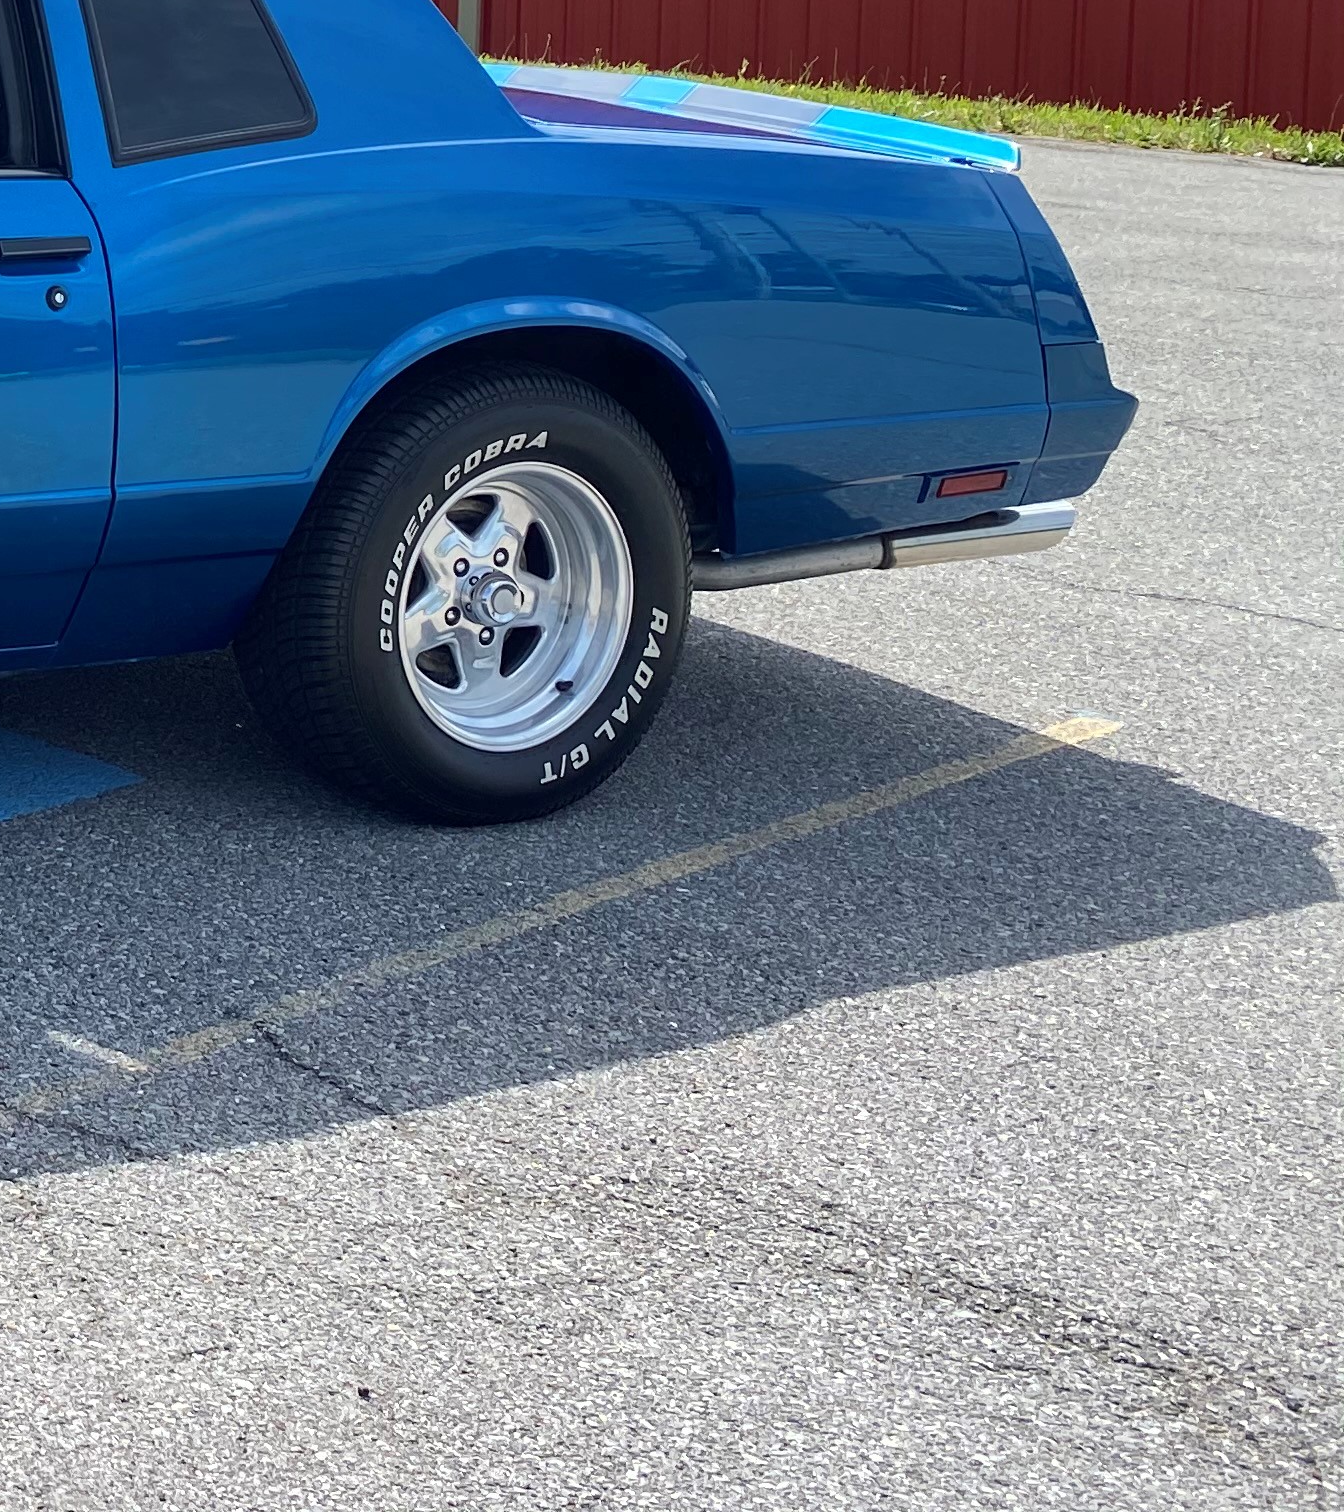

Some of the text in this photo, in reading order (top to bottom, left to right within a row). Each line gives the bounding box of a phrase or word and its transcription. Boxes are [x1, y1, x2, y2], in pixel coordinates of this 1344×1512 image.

[379, 431, 548, 652] COOPER COBRA
[540, 606, 669, 784] RADIAL G/T
